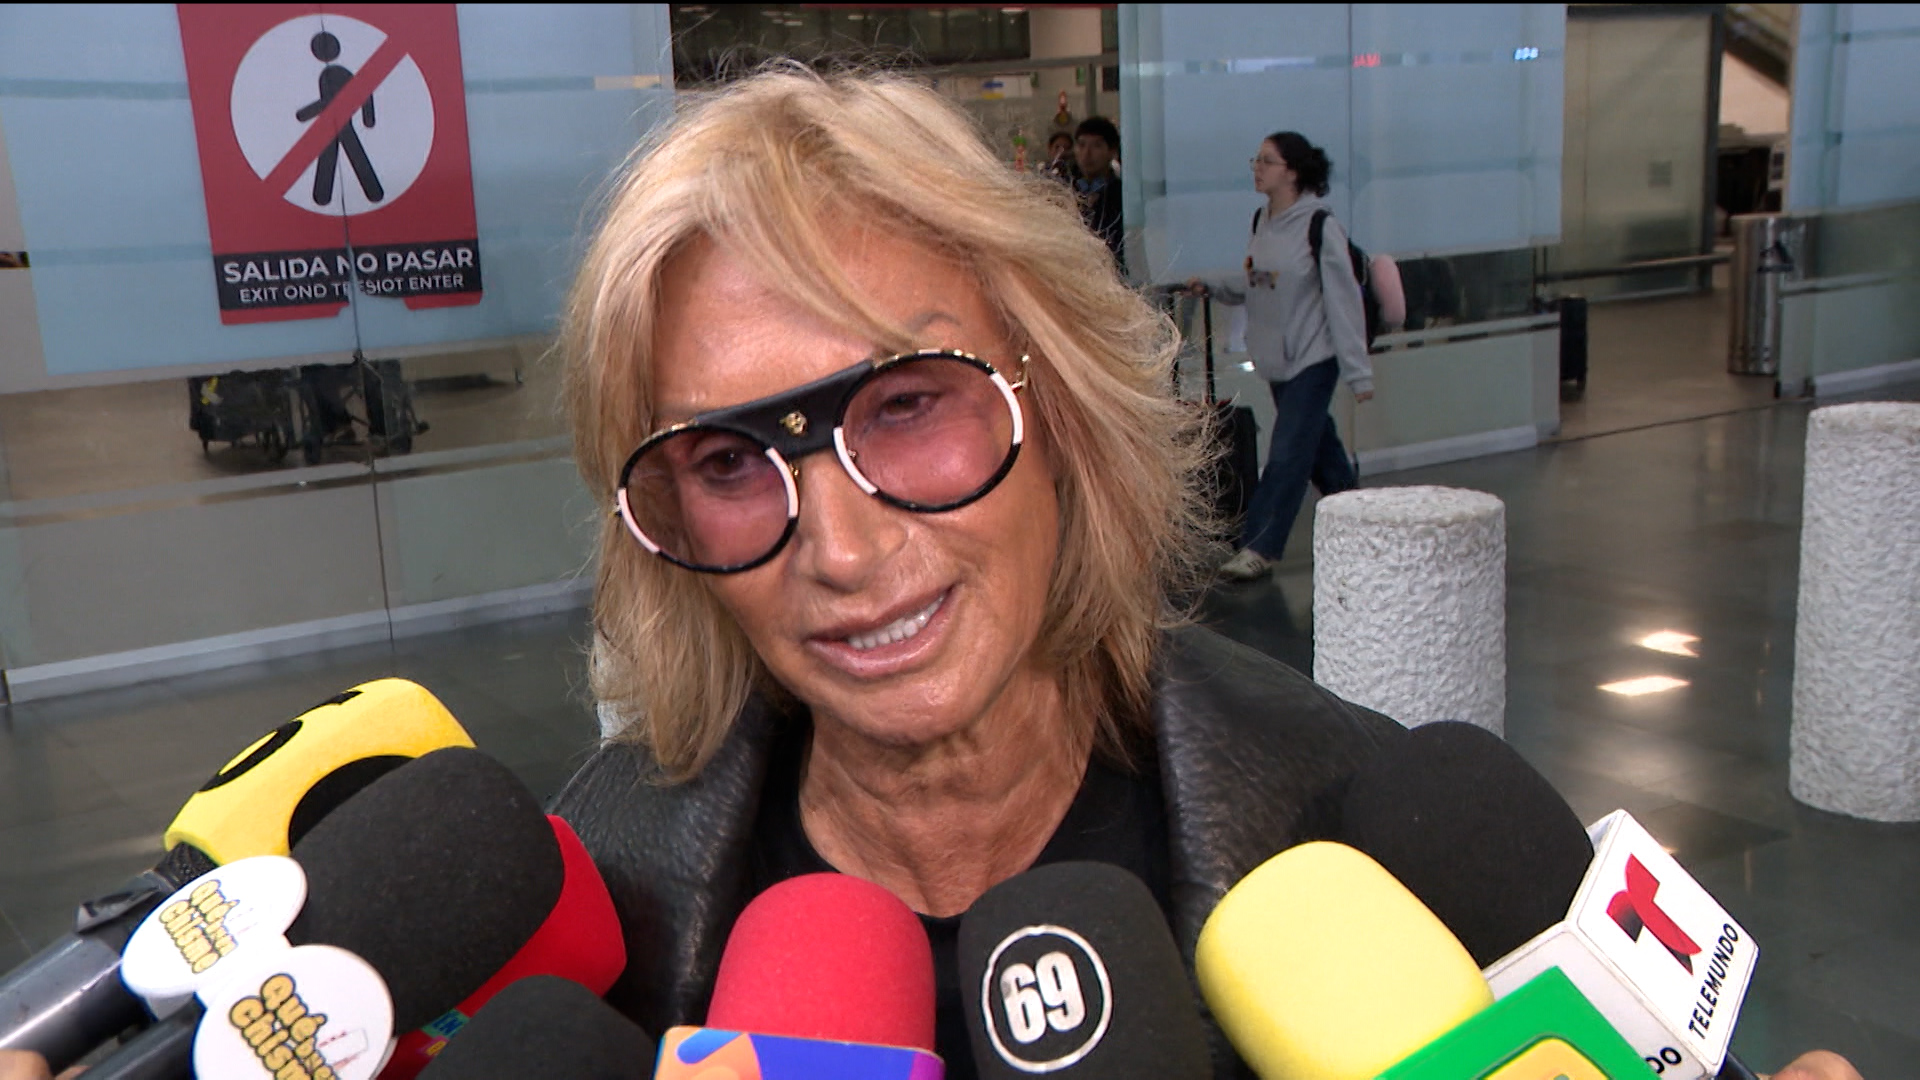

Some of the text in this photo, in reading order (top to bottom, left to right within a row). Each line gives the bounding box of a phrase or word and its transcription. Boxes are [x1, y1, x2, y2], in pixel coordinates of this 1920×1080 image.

[223, 247, 473, 283] SALIDA NO PASAR
[239, 286, 279, 303] EXIT
[409, 273, 464, 291] ENTER
[259, 972, 328, 1037] Qué
[1000, 951, 1086, 1044] 69
[1688, 923, 1738, 1040] TELEMUNDO
